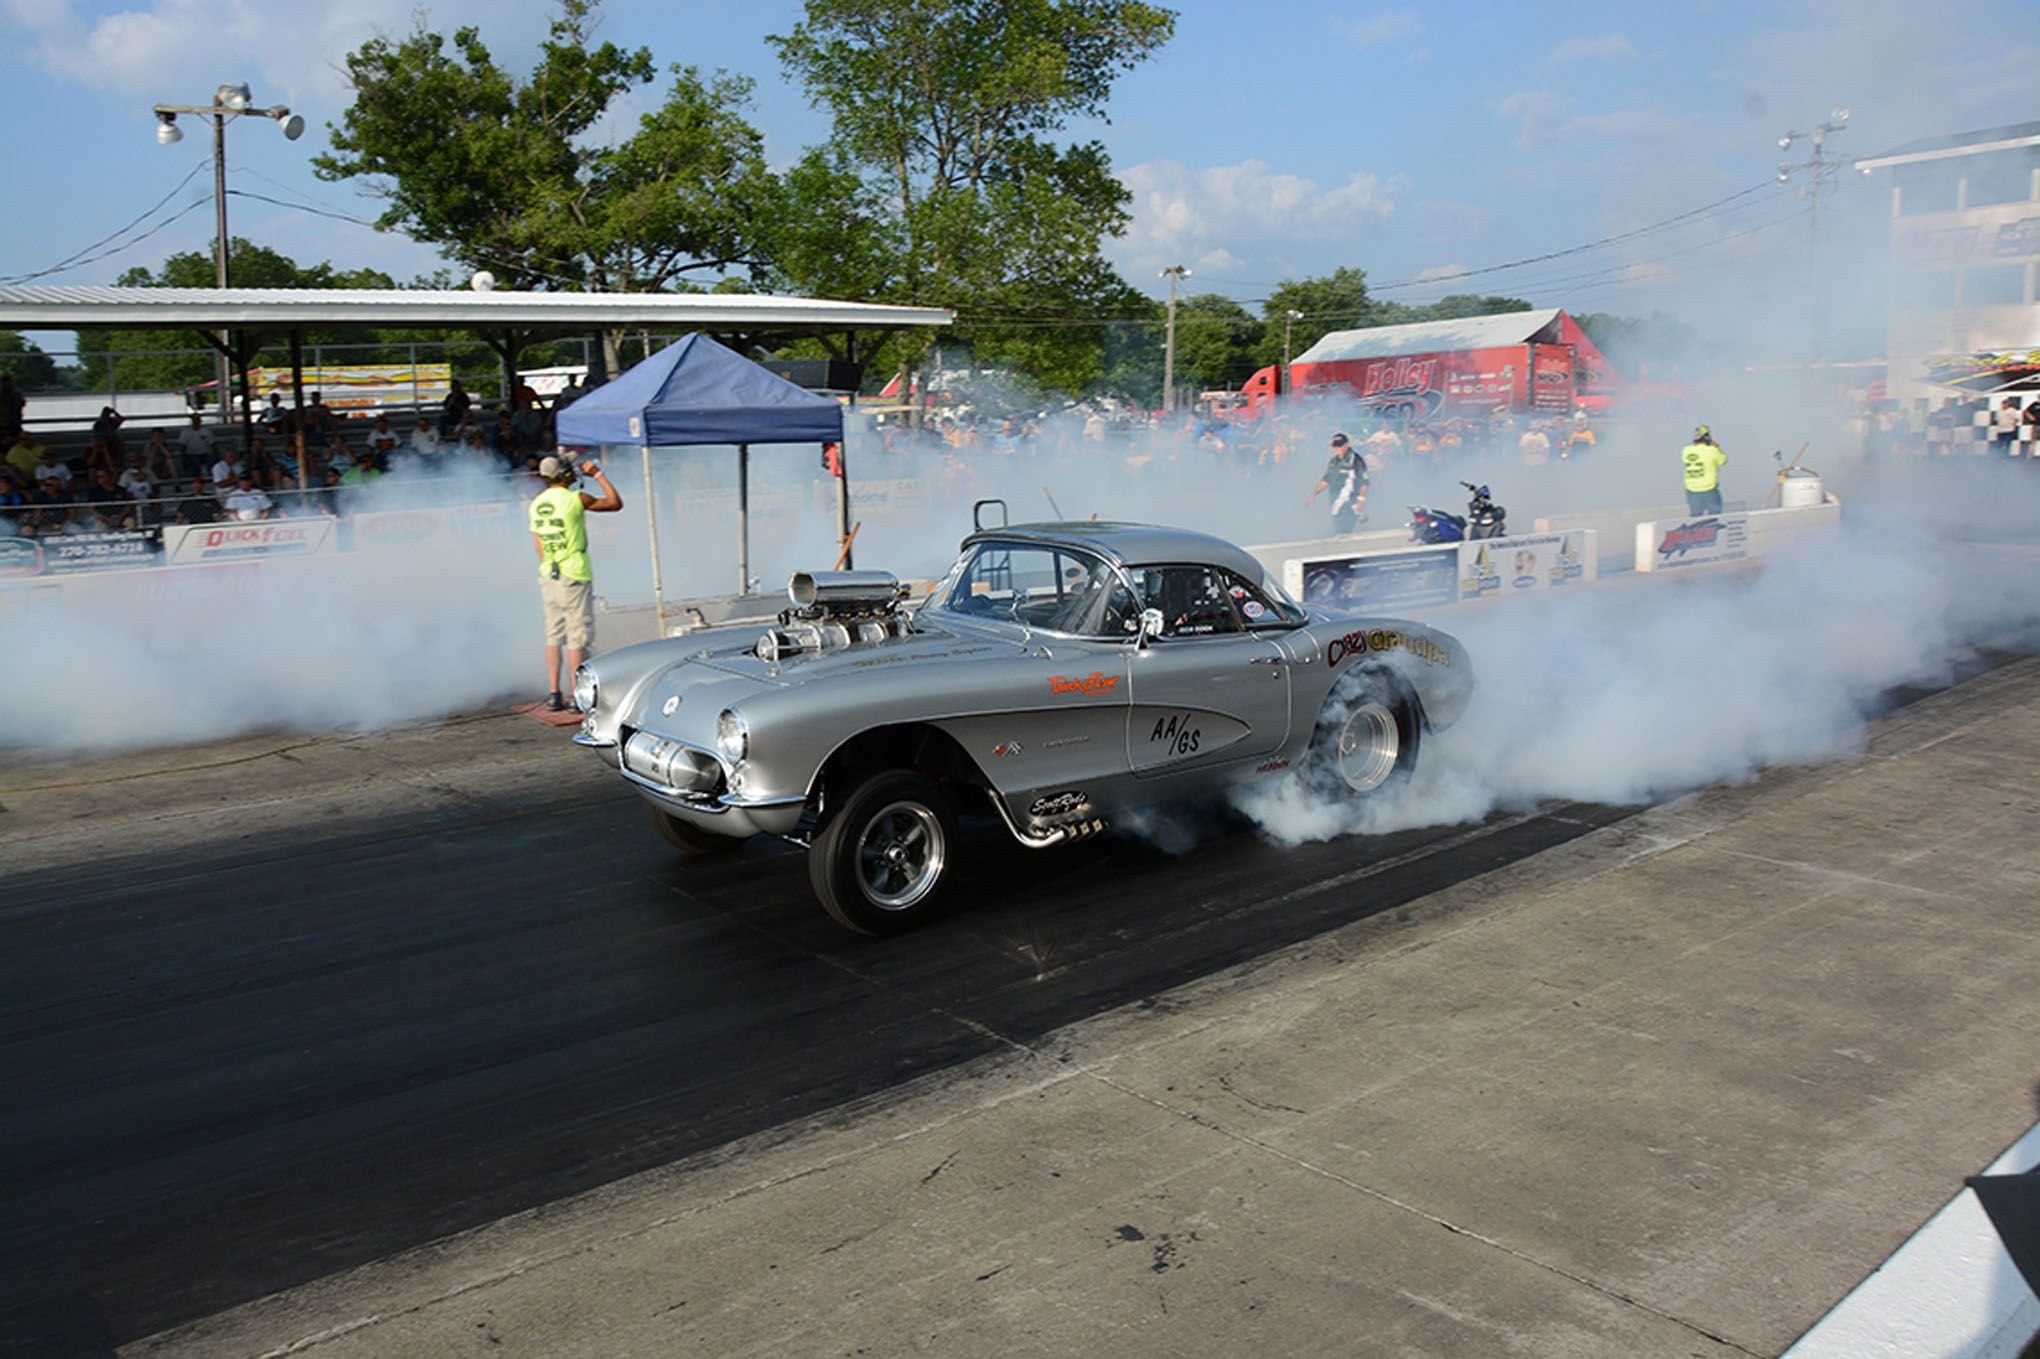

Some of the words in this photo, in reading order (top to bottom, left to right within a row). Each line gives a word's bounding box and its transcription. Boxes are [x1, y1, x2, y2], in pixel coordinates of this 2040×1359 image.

[1363, 357, 1438, 396] Holley
[1367, 627, 1450, 668] Grandpa
[1150, 713, 1200, 756] AA/GS
